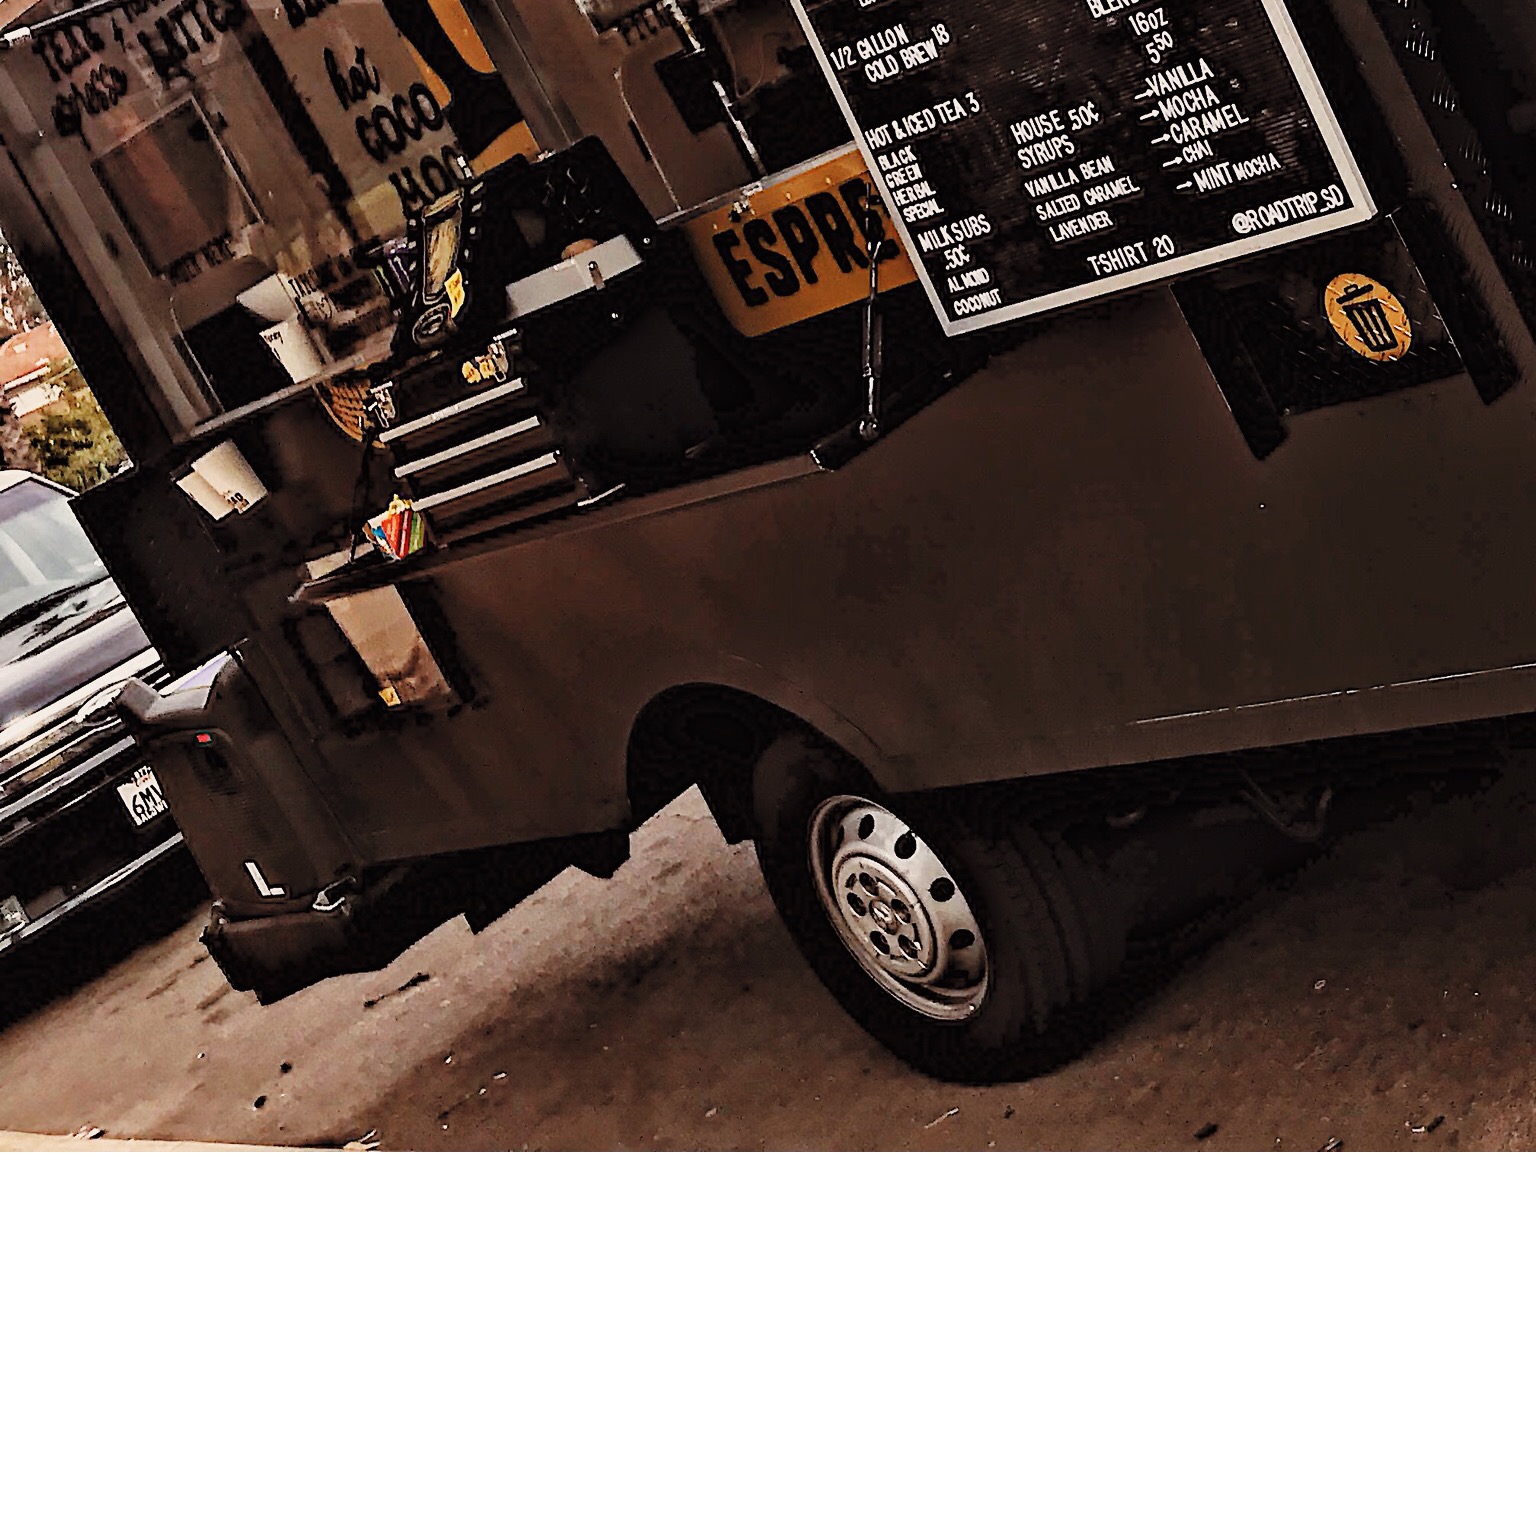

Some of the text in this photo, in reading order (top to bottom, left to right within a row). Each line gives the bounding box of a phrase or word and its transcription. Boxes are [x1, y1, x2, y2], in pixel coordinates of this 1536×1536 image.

[829, 24, 910, 71] 1/2 GALLON
[864, 24, 950, 83] COLD BREW 18
[323, 46, 380, 111] hot
[1145, 58, 1214, 97] VANILLA
[865, 125, 890, 150] HOT
[934, 97, 967, 124] TEA
[965, 92, 980, 113] 3
[1157, 84, 1220, 122] MOCHA
[355, 82, 444, 163] COCO
[1010, 109, 1066, 145] HOUSE
[1169, 103, 1249, 145] CARAMEL
[877, 145, 917, 171] BLACK
[1017, 134, 1075, 169] SYRUPS
[1181, 140, 1214, 165] CHAI
[885, 163, 923, 189] GREEN
[1024, 156, 1115, 198] VANILLA BEAN
[1193, 153, 1281, 192] MINT MOCHA
[893, 181, 936, 206] HERBAL
[903, 198, 945, 223] SPECIAL
[1036, 176, 1140, 220] SALTED CARAMEL
[1231, 184, 1345, 235] @ROADTRIP_SD
[917, 214, 991, 252] MILK SUBS
[1049, 210, 1113, 242] LAVENDER
[1152, 234, 1175, 258] 20
[948, 267, 990, 293] ALMOND
[954, 289, 1002, 316] COCONUT
